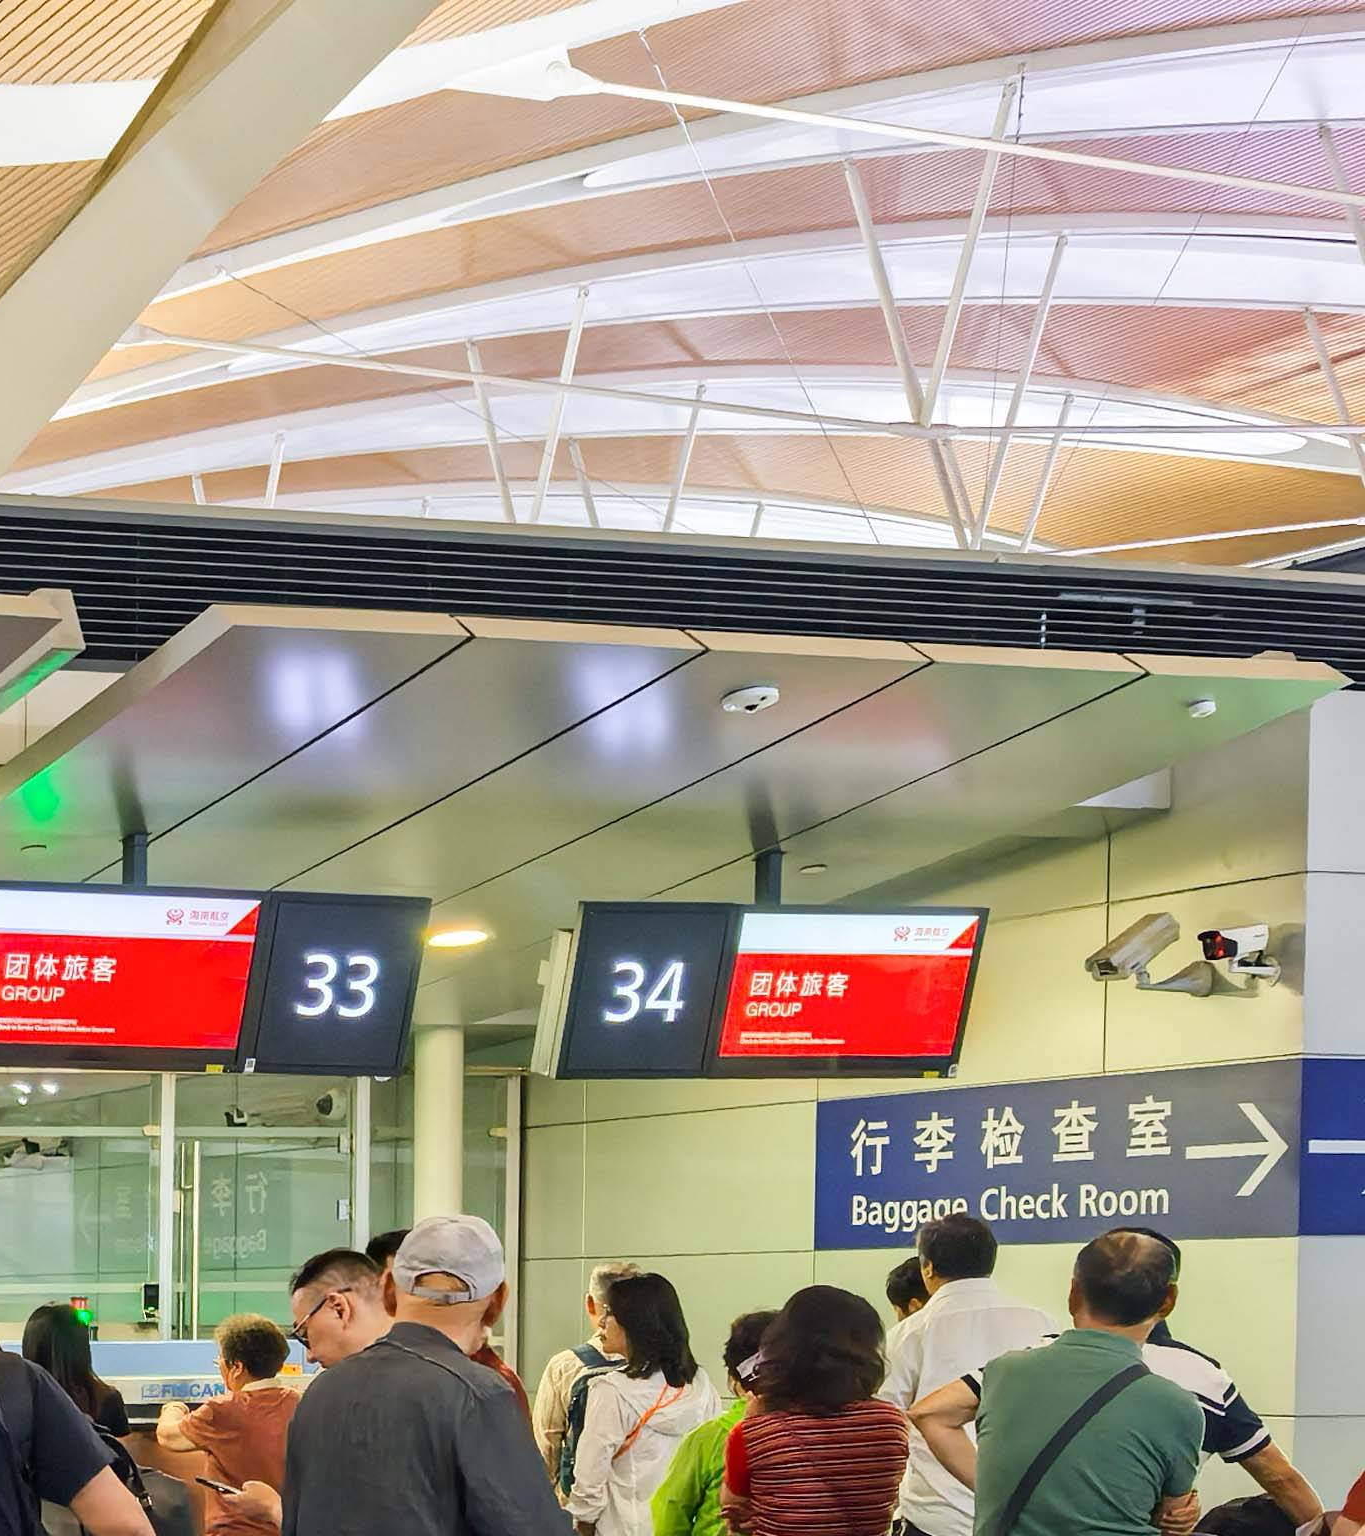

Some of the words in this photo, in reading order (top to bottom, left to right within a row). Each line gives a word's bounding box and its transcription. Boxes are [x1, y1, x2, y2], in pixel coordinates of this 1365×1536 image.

[4, 953, 118, 985] 团体旅客
[296, 954, 380, 1018] 33
[749, 972, 849, 999] 团体旅客
[1, 985, 65, 1003] GROUP
[604, 962, 685, 1023] 34
[745, 1003, 803, 1018] GROUP
[850, 1096, 1173, 1177] 行李检查室
[851, 1194, 969, 1235] Baggage
[980, 1182, 1069, 1222] Check
[1079, 1184, 1171, 1218] Room
